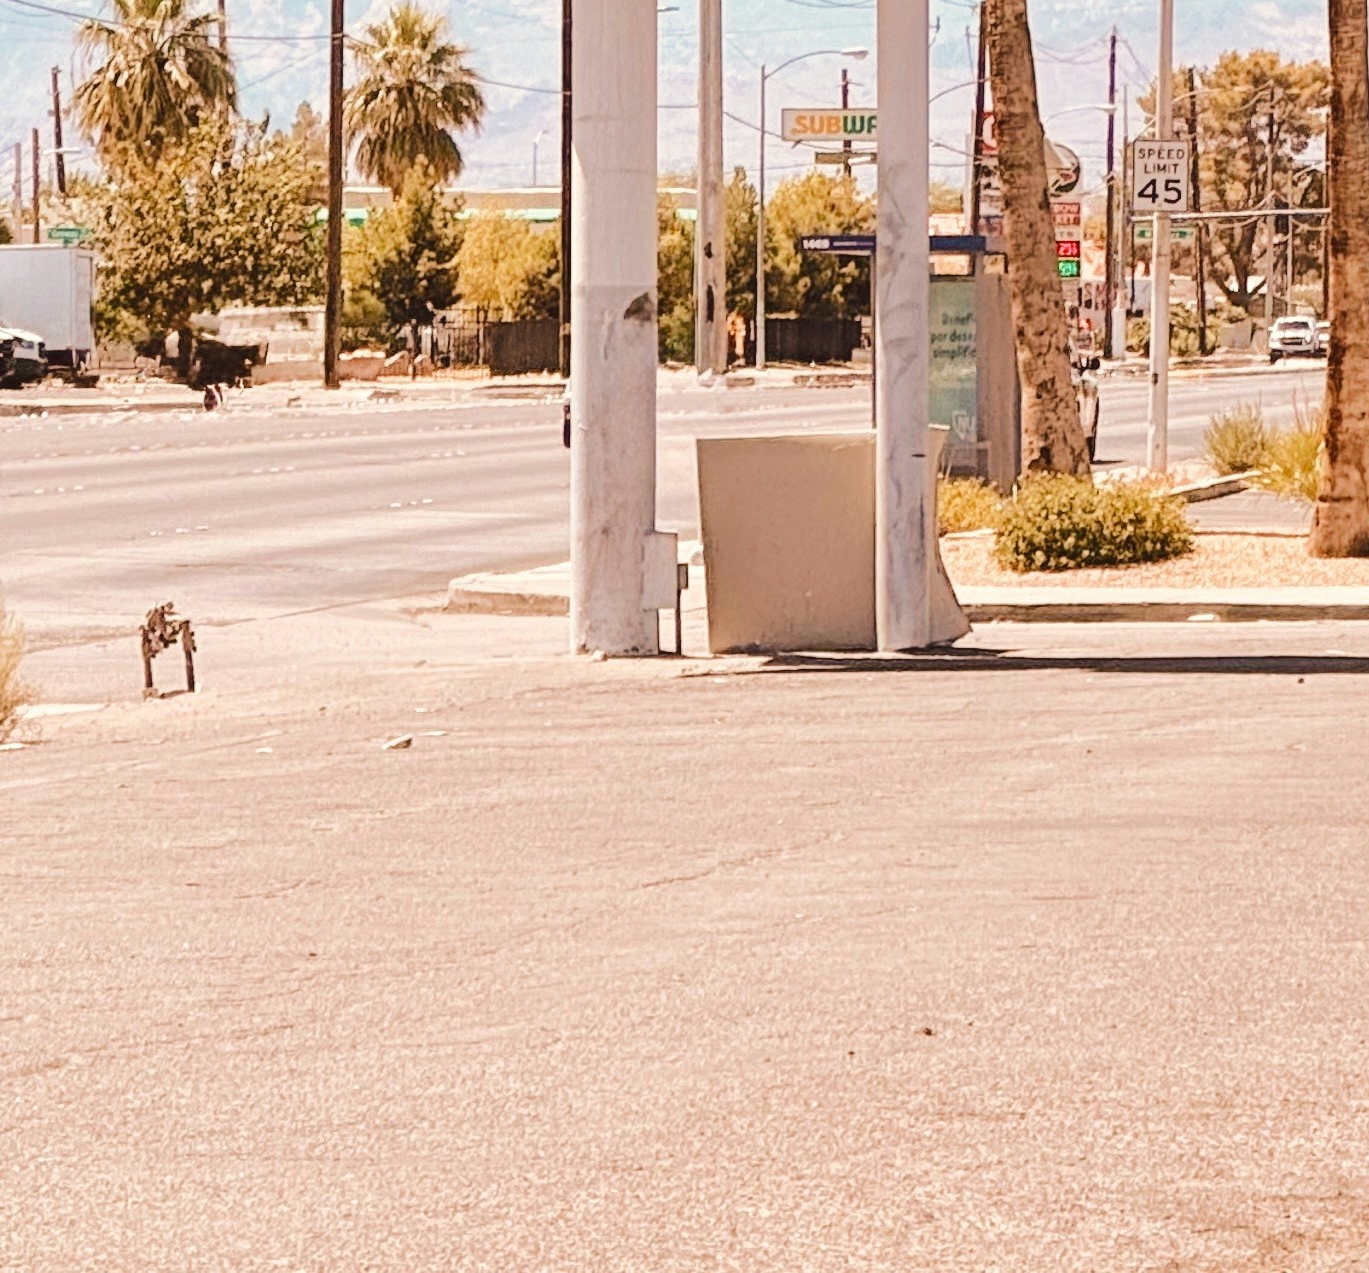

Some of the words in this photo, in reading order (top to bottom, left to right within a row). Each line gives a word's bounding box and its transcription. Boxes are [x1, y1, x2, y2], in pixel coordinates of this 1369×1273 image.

[790, 114, 877, 134] SUBWA
[1138, 147, 1185, 159] SPEED
[1144, 163, 1179, 174] LIMIT
[1137, 178, 1182, 204] 45
